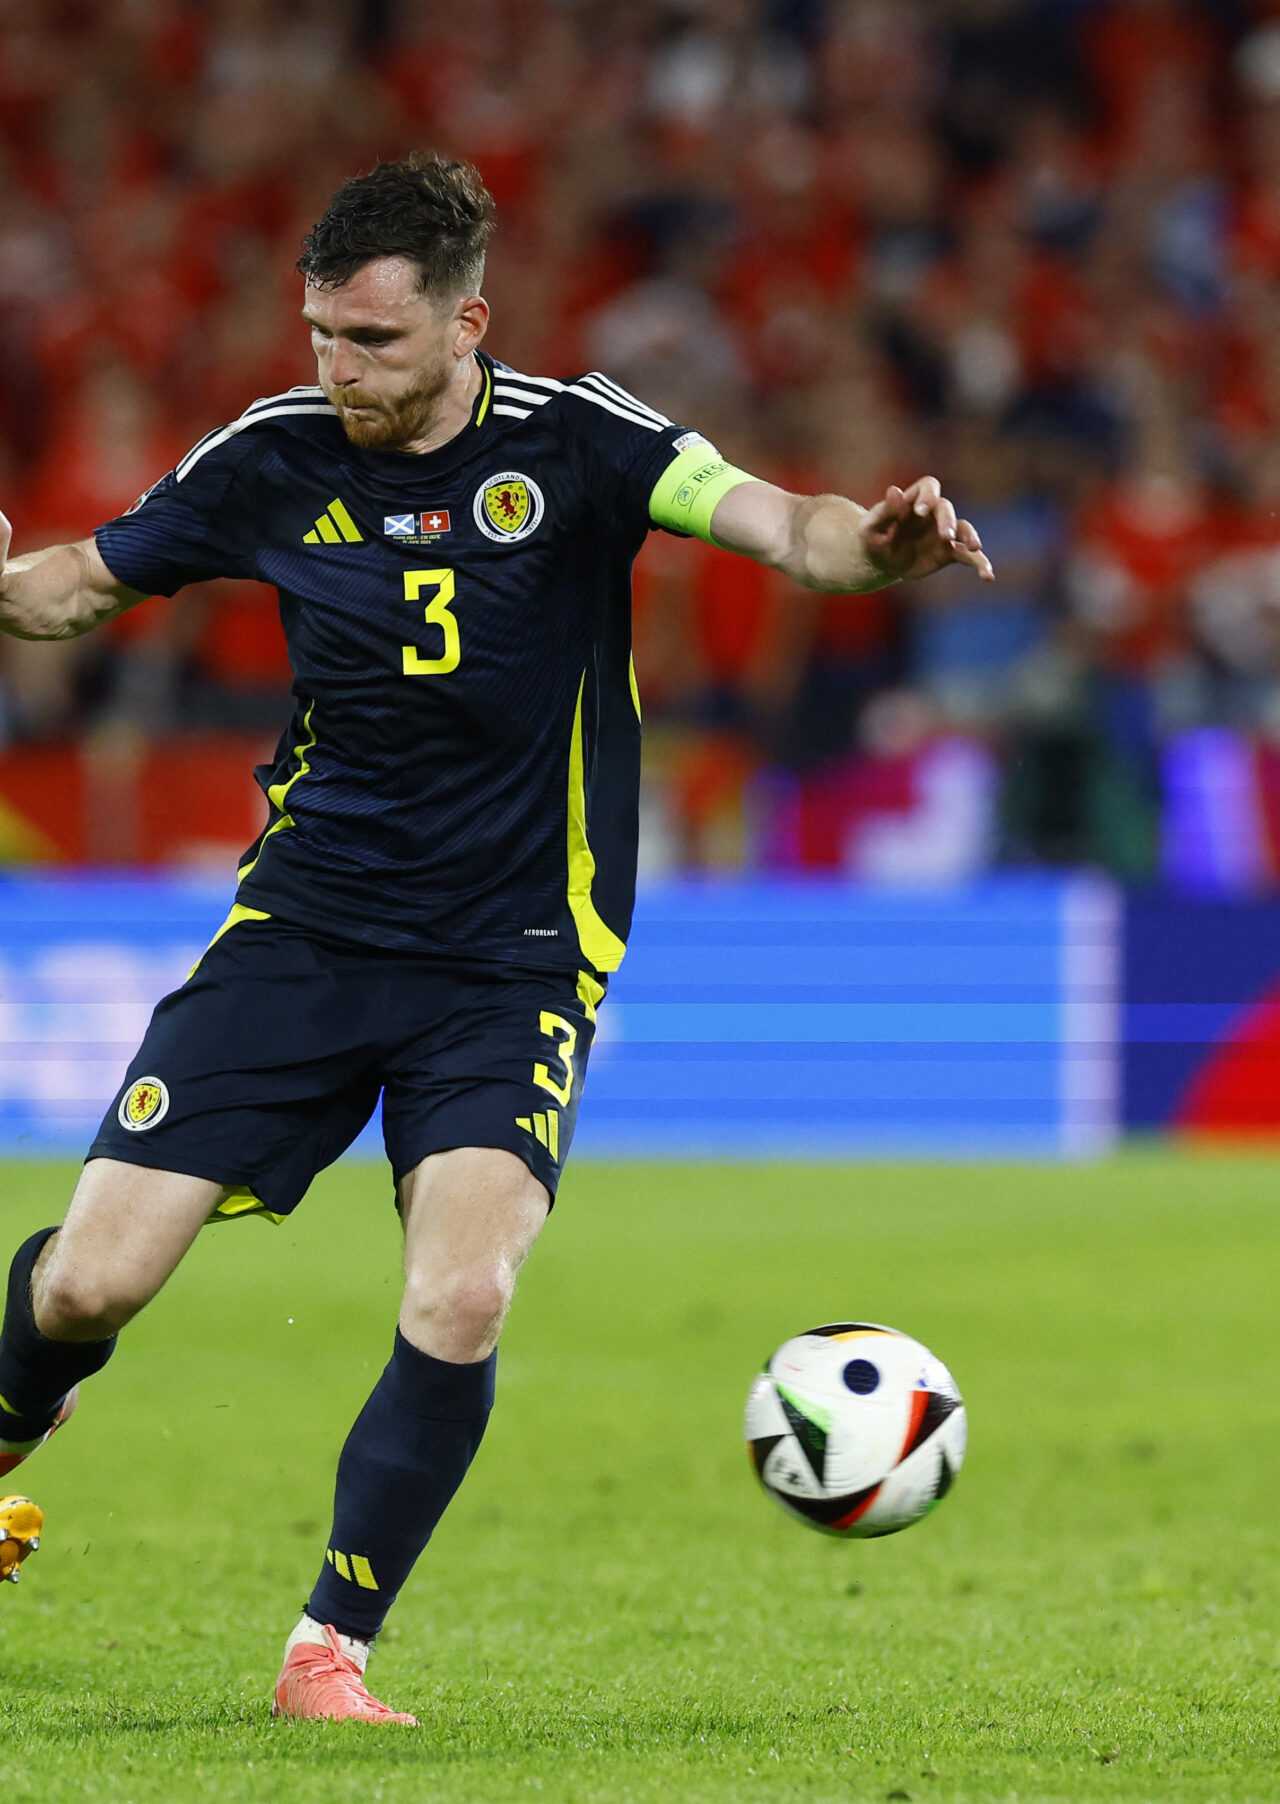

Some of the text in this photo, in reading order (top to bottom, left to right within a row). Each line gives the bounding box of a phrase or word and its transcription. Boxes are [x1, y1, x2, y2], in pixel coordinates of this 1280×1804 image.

[486, 474, 520, 487] SCOTLAND
[693, 464, 727, 483] RES
[402, 568, 461, 676] 3
[532, 1010, 577, 1108] 3
